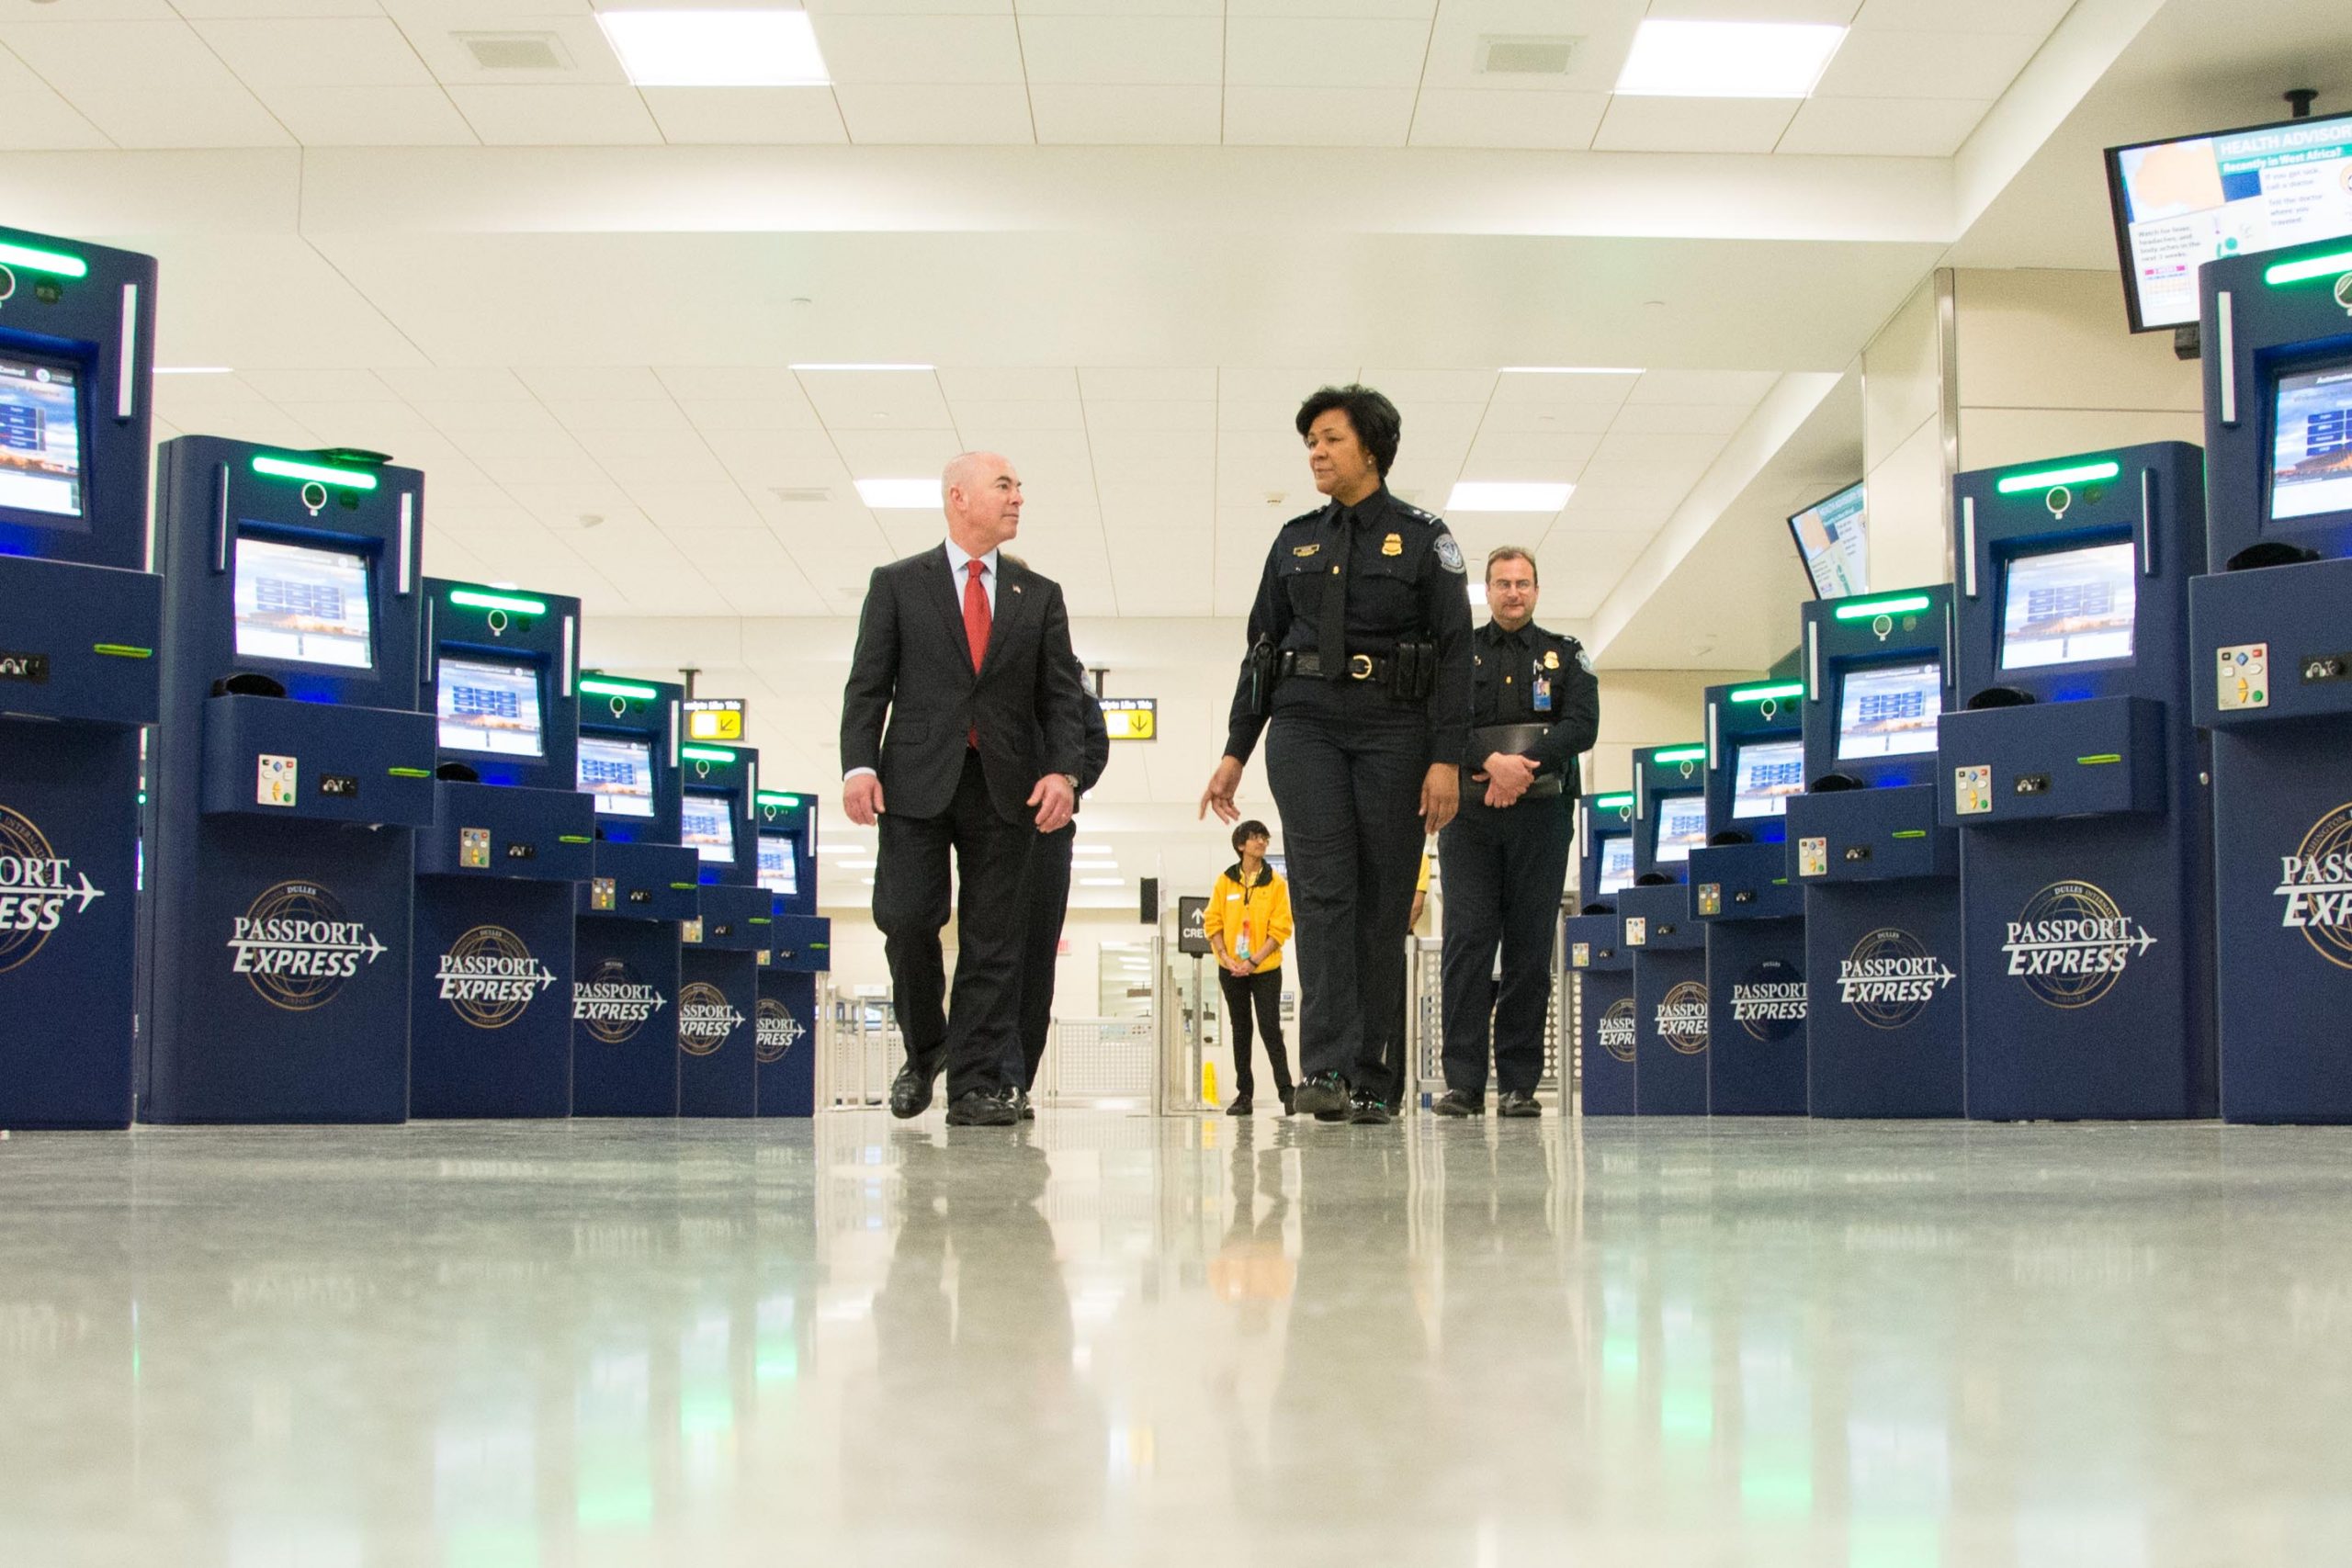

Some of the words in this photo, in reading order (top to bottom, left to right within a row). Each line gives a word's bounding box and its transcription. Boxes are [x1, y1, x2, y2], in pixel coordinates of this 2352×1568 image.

[2221, 135, 2279, 154] HEALTH
[2223, 159, 2266, 173] Recently
[2268, 157, 2278, 165] in
[2279, 153, 2304, 165] West
[2306, 148, 2341, 161] Africa?
[287, 886, 317, 896] DULLES
[2053, 886, 2083, 896] DULLES
[233, 917, 364, 945] PASSPORT
[1183, 928, 1205, 938] CRE
[2006, 917, 2132, 944] PASSPORT
[232, 946, 360, 977] EXPRESS
[439, 955, 538, 976] PASSPORT
[1840, 957, 1937, 977] PASSPORT
[2007, 946, 2129, 976] EXPRESS
[439, 976, 536, 1002] EXPRESS
[573, 982, 653, 999] PASSPORT
[1734, 982, 1808, 999] PASSPORT
[1841, 980, 1935, 1003] EXPRESS
[573, 1000, 650, 1021] EXPRESS
[680, 1004, 733, 1019] SSPORT
[1657, 1003, 1708, 1017] PASSPO
[1734, 1001, 1808, 1021] EXPRESS
